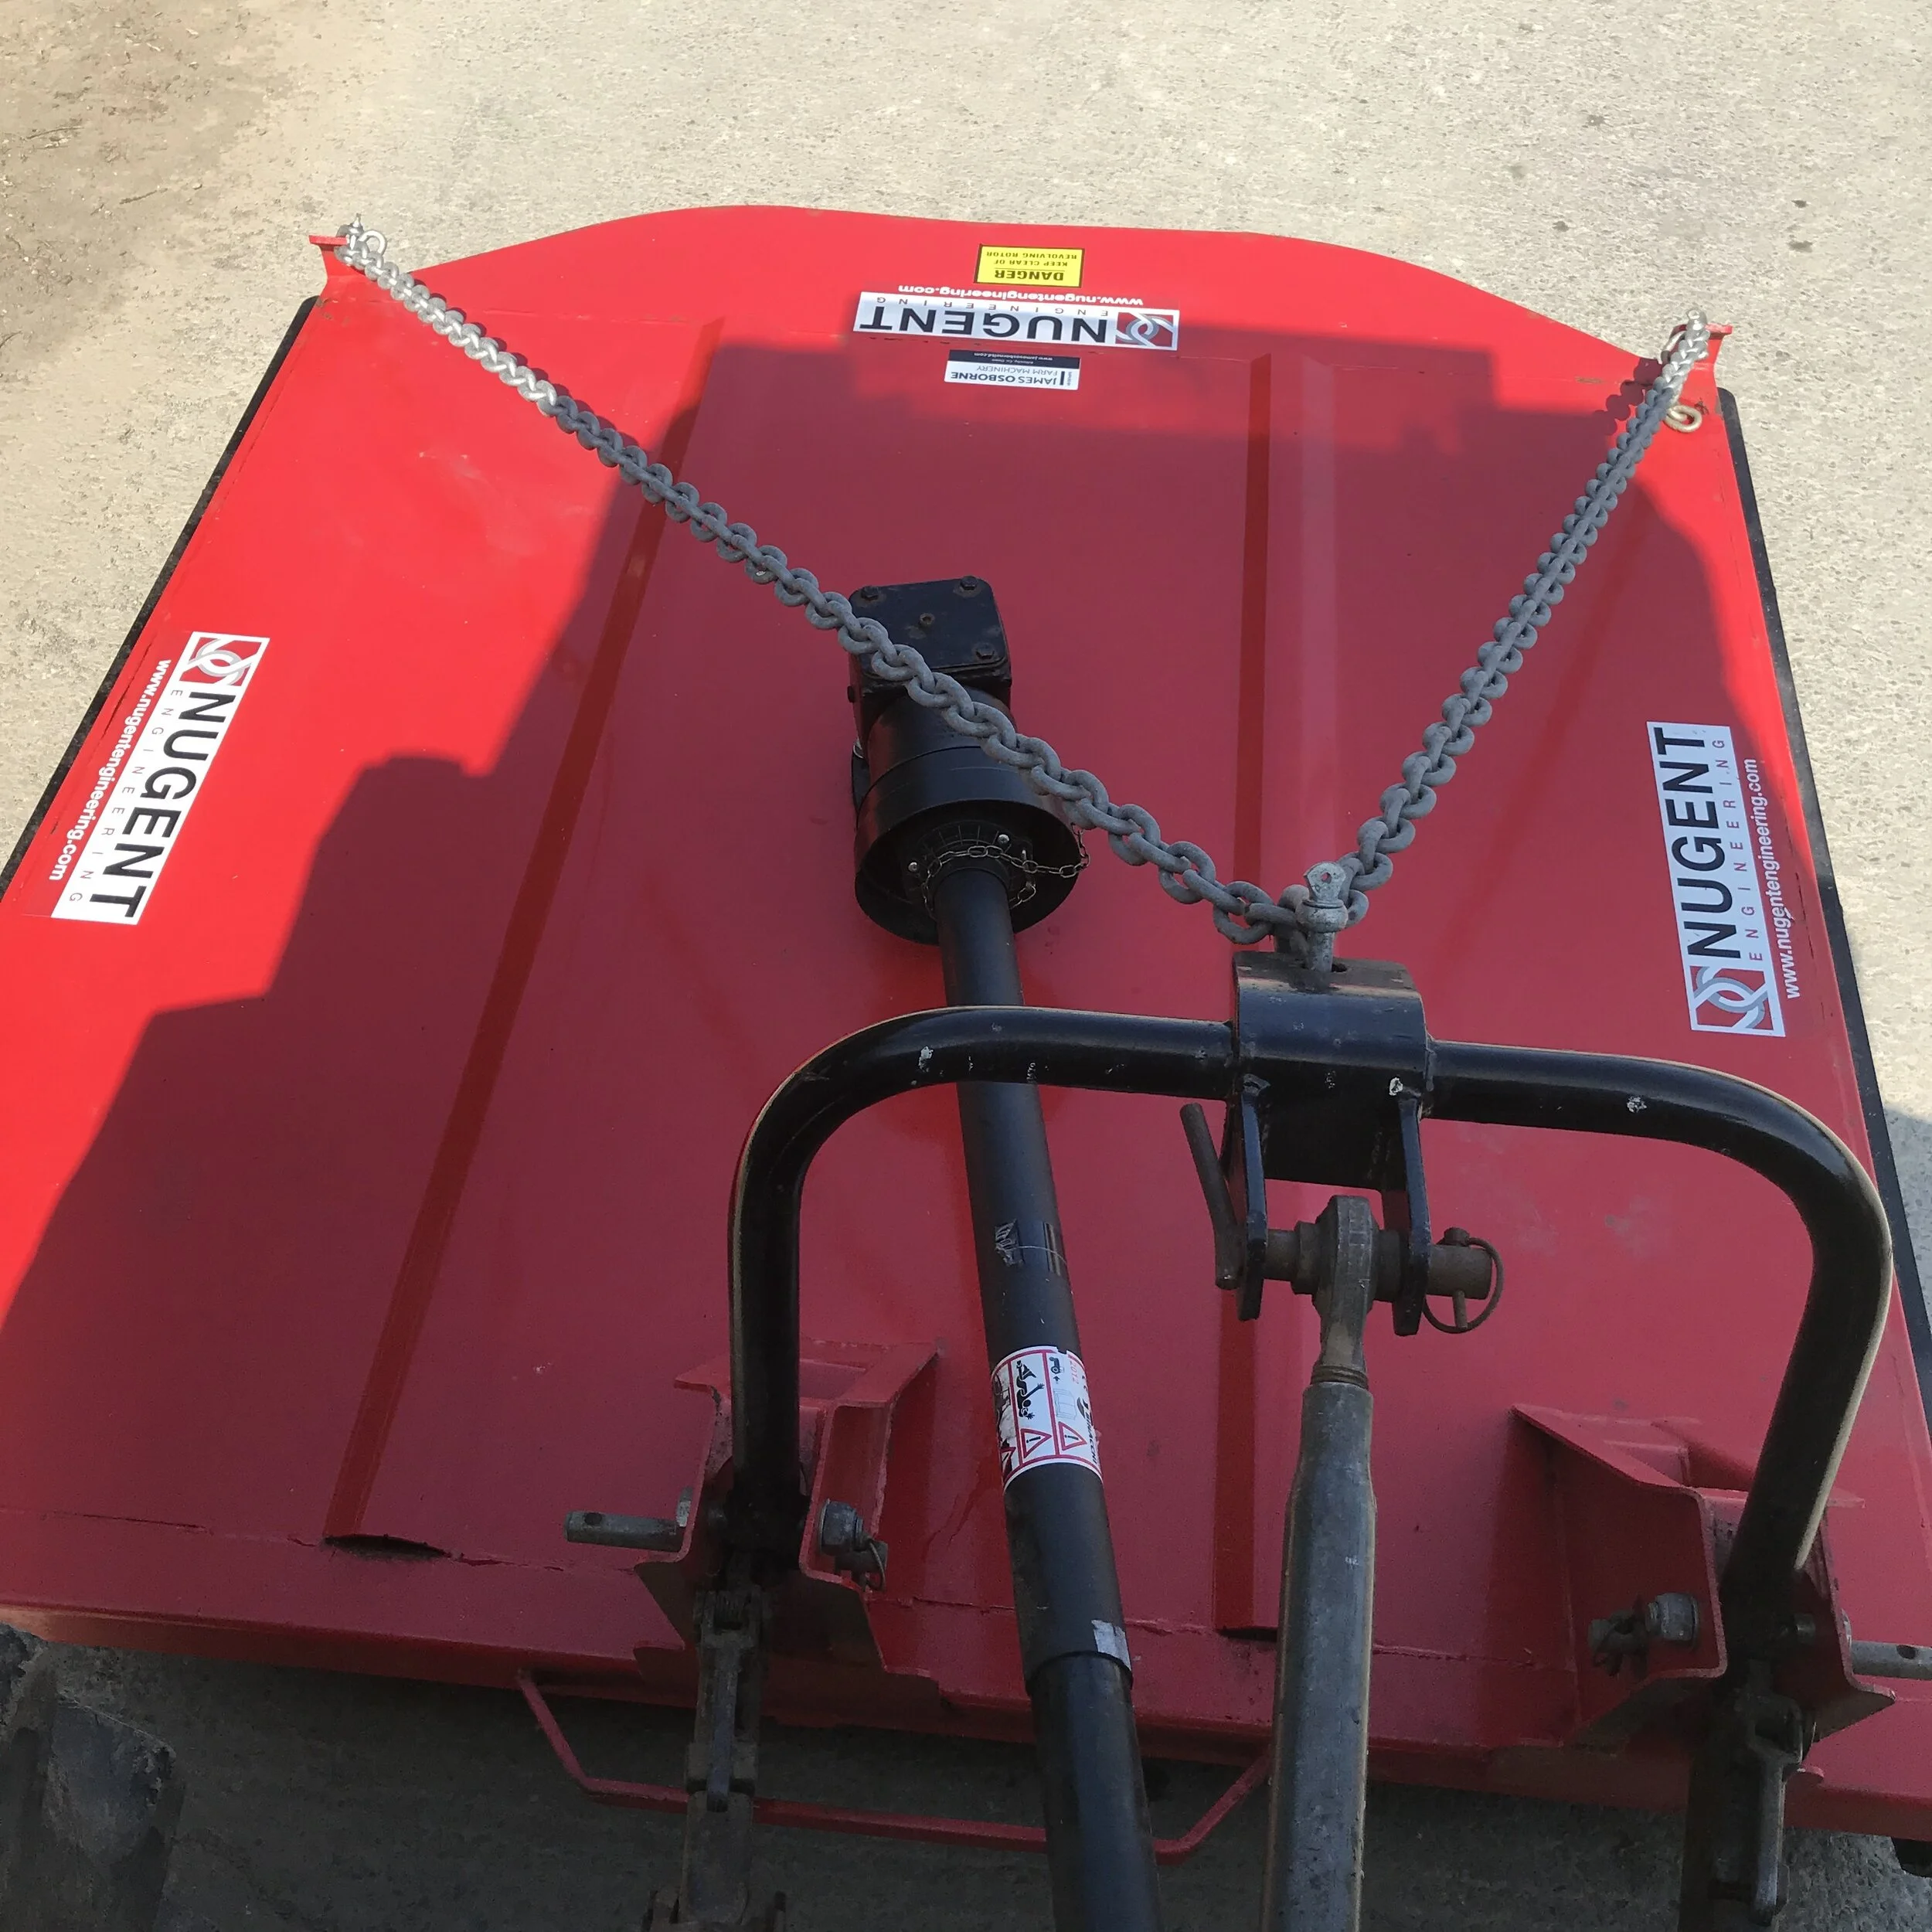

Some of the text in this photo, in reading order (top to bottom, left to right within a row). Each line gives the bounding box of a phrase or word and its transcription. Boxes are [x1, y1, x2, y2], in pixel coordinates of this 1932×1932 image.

[898, 285, 1143, 305] www.nugentengineering.com
[995, 270, 1064, 281] DANGER
[859, 305, 1107, 344] NUGENT
[876, 297, 1109, 317] ENGINEERING
[951, 372, 1015, 383] OSBORNE
[977, 365, 1030, 373] MACHINERY
[1018, 376, 1056, 386] JAMES
[49, 659, 172, 881] www.nugentengineering.com
[69, 689, 183, 903] ENGINEERING
[90, 692, 236, 917] NUGENT
[1653, 726, 1741, 959] NUGENT
[1712, 740, 1764, 962] ENGINEERING
[1743, 758, 1800, 999] www.nugentengineering.com
